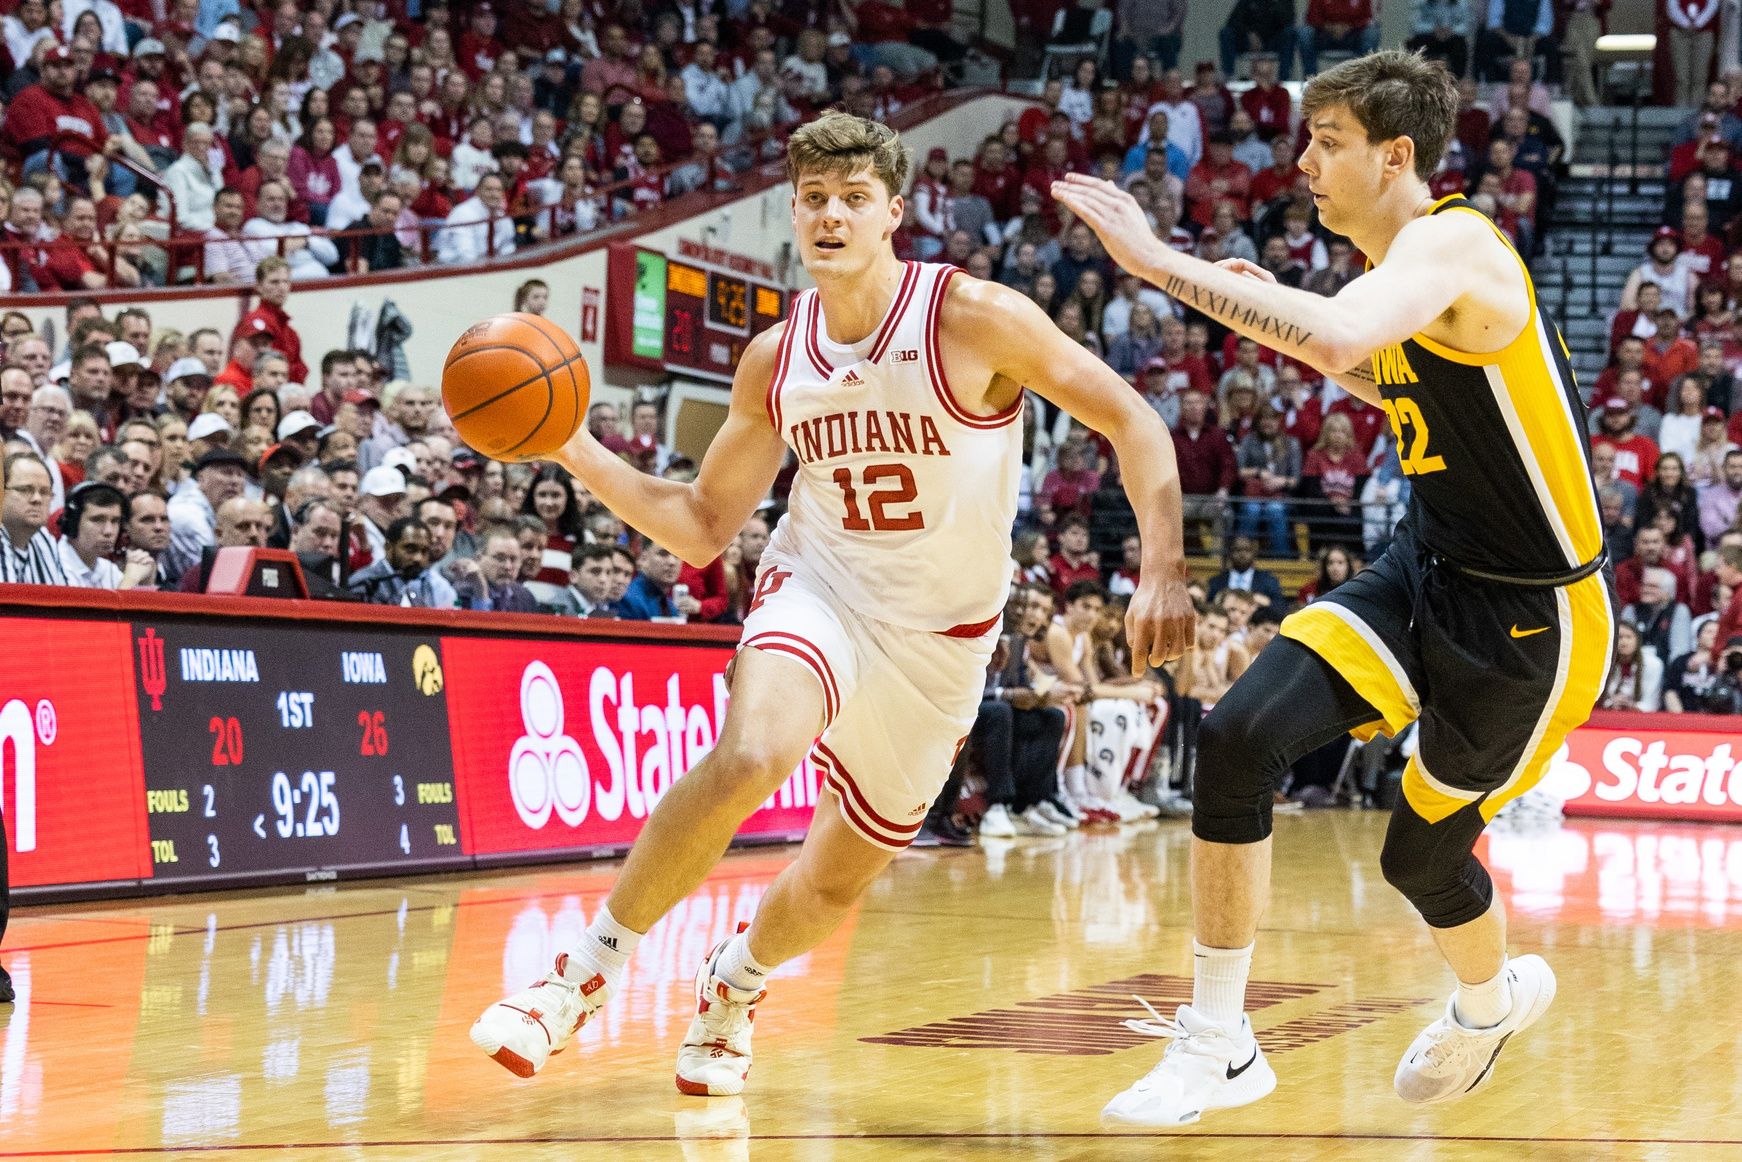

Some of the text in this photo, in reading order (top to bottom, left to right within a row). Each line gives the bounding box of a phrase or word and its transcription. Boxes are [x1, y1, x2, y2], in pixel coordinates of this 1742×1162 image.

[791, 410, 951, 465] INDIANA
[832, 463, 925, 531] 12
[180, 648, 260, 682] INDIANA
[341, 652, 387, 683] IOWA
[276, 691, 314, 728] 1ST
[209, 716, 244, 766] 20
[357, 710, 389, 757] 26
[589, 666, 712, 822] State
[393, 774, 453, 806] 3 FOULS
[1594, 737, 1742, 805] Stat
[147, 784, 217, 818] FOULS 2
[272, 771, 340, 838] 9:25
[151, 834, 221, 868] TOL 3
[400, 823, 457, 855] 4 TOL
